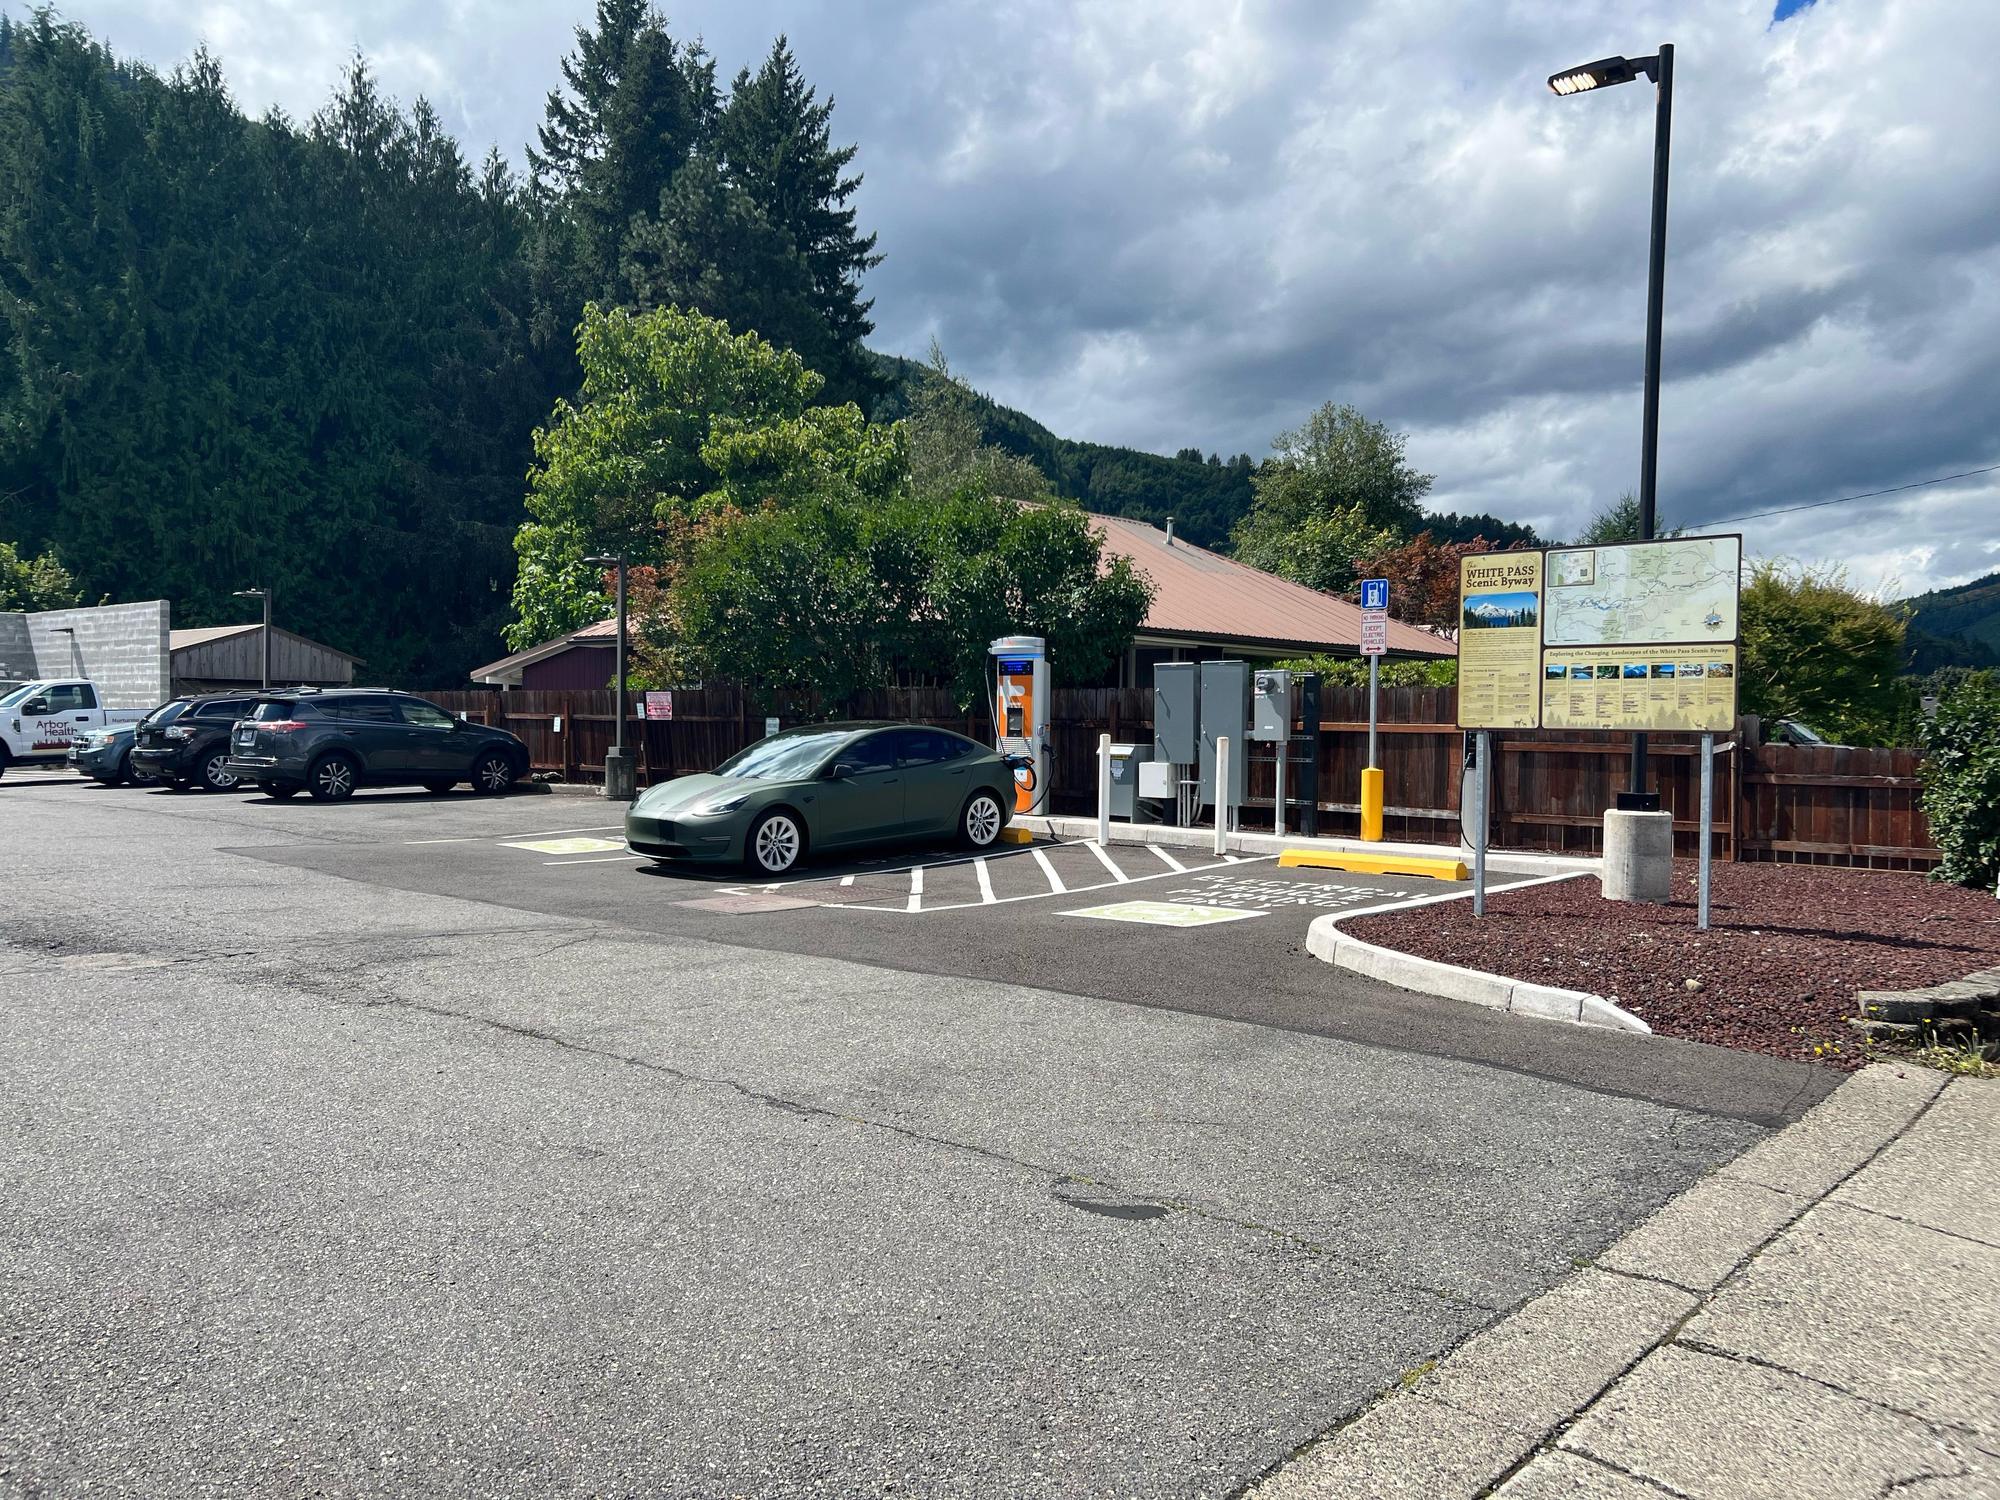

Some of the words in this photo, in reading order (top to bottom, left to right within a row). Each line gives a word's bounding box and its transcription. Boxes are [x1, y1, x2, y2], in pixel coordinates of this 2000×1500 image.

[1466, 567, 1504, 579] WHITE
[1507, 565, 1535, 577] PASS
[1466, 577, 1499, 588] Scenic
[1501, 576, 1535, 588] Byway
[36, 720, 69, 729] Arbor
[44, 727, 78, 737] Health
[1192, 875, 1429, 898] ELECTRICAL
[1206, 883, 1373, 902] VEHICLE
[1165, 888, 1349, 908] PARKING
[1168, 896, 1286, 909] ONLY
